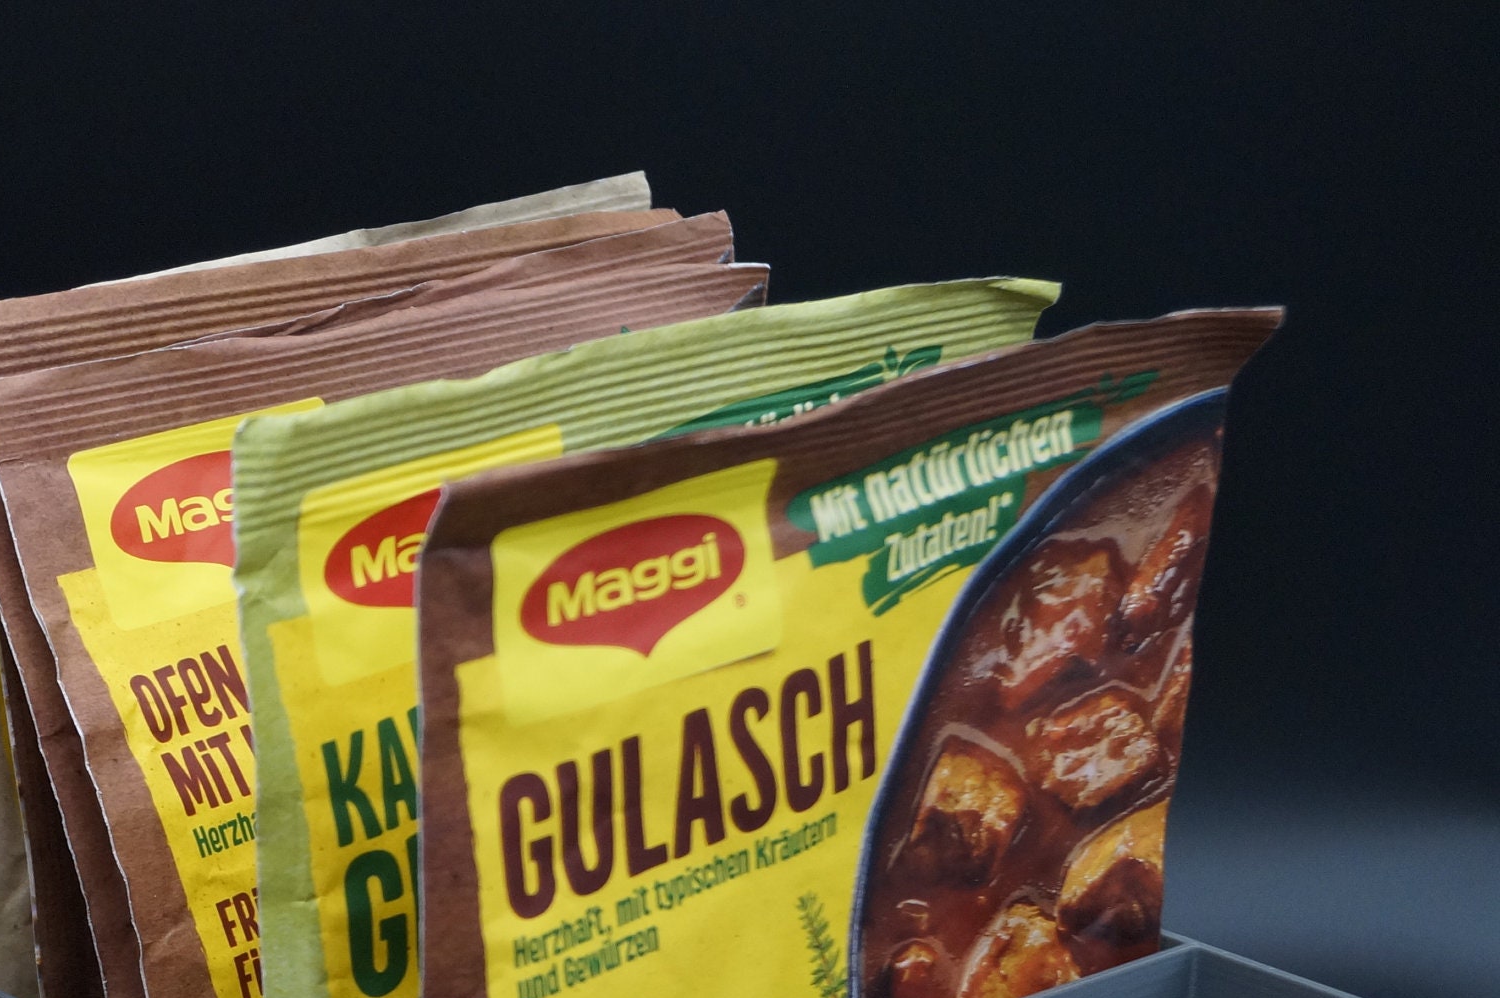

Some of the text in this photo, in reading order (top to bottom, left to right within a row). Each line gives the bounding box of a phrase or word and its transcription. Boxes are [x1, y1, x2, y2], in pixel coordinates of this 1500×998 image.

[809, 484, 868, 543] Mit
[863, 410, 1075, 524] natürlichen
[546, 532, 722, 626] Maggi
[499, 638, 877, 920] GULASCH
[512, 810, 838, 969] Herzhaft, mit typischen Kräutern
[563, 925, 660, 989] Gewürzen
